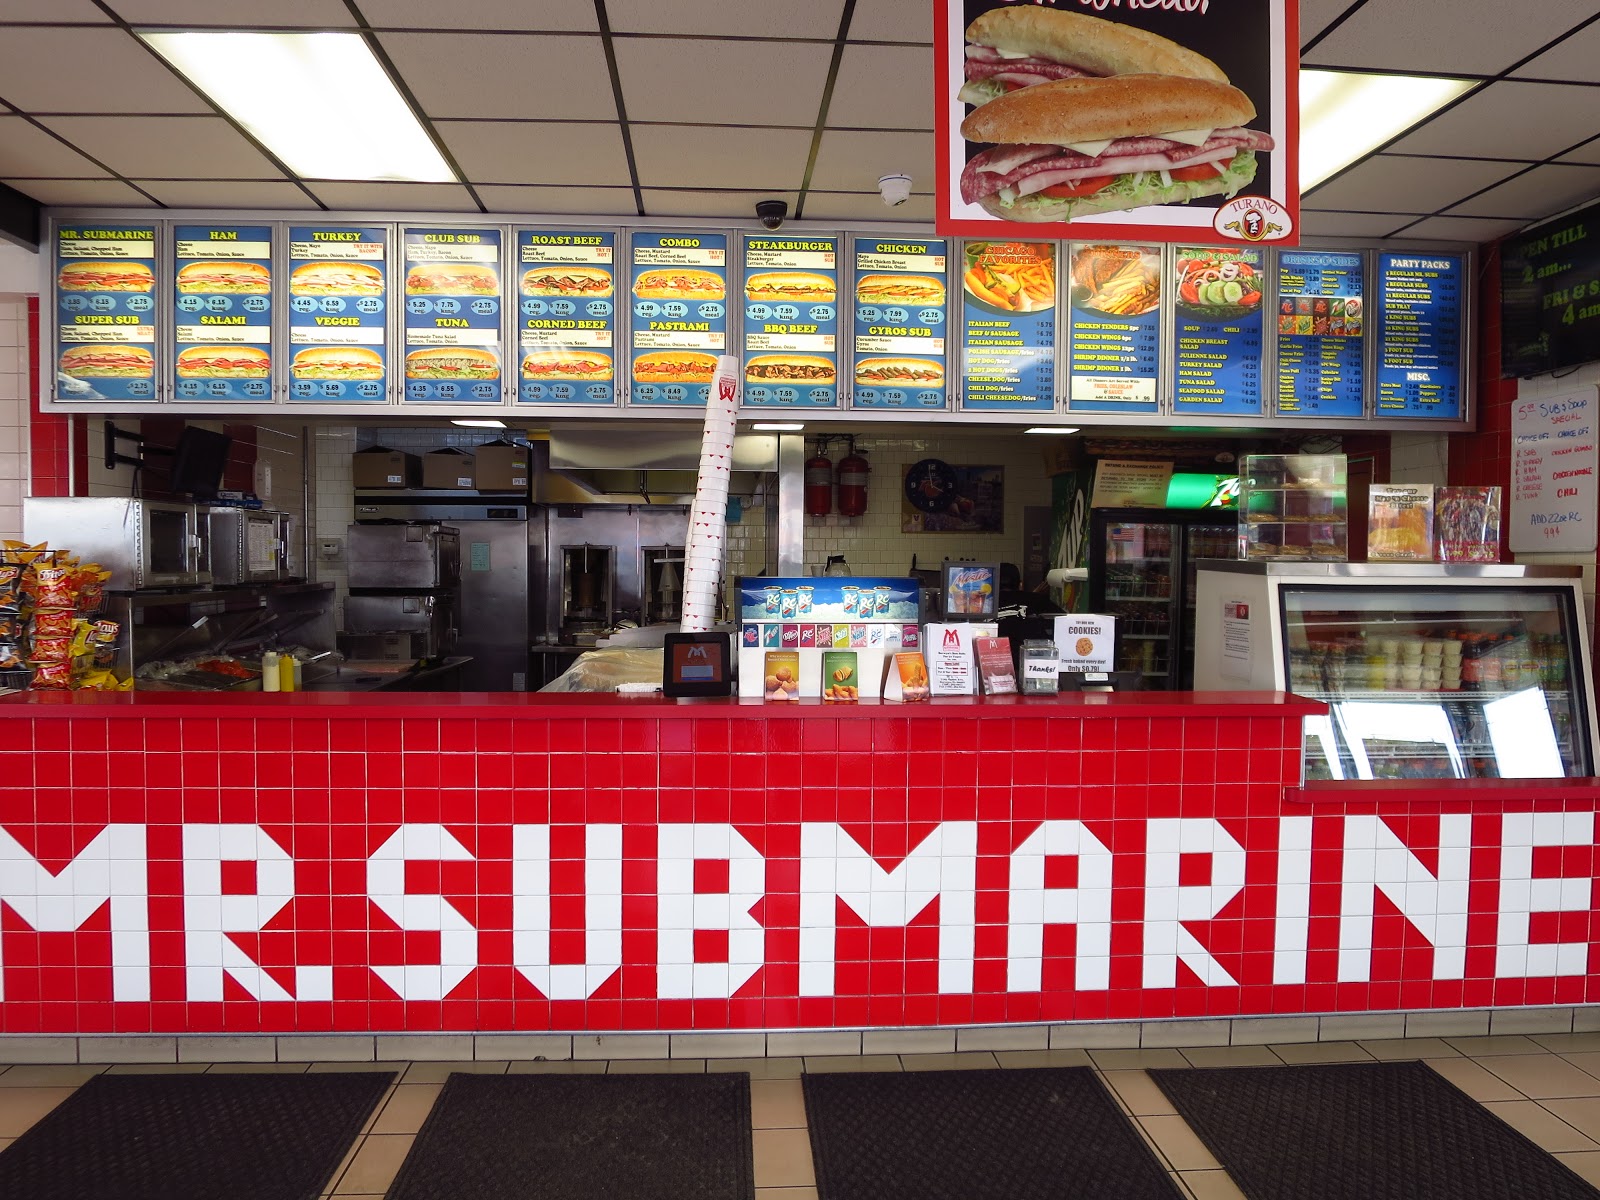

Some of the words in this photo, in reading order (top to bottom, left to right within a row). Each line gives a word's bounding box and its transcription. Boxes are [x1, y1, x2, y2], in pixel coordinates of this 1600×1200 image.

[1229, 200, 1278, 216] TURANO
[60, 231, 80, 239] MR.
[82, 231, 154, 239] SUBMARINE
[210, 231, 236, 240] HAM
[313, 232, 361, 241] TURKEY
[424, 234, 455, 243] CLUB
[457, 235, 480, 243] SUB
[532, 235, 571, 245] ROAST
[574, 236, 603, 245] BEEF
[1552, 224, 1587, 248] TILL
[660, 238, 700, 248] COMBO
[749, 241, 833, 251] STEAKBURGER
[876, 244, 926, 254] CHICKEN
[985, 246, 1036, 256] CHICAGO
[979, 255, 1041, 265] FAVORITES
[1182, 252, 1212, 261] SOUP
[1222, 254, 1259, 263] SALAD
[1391, 259, 1420, 268] PARTY
[1421, 260, 1450, 269] PACKS
[1543, 289, 1569, 310] FRI
[1572, 284, 1585, 300] &
[1562, 303, 1575, 325] 4
[75, 316, 114, 324] SUPER
[116, 316, 140, 324] SUB
[200, 316, 246, 325] SALAMI
[315, 317, 360, 326] VEGGIE
[435, 319, 469, 327] TUNA
[527, 320, 575, 329] CORNED
[578, 321, 607, 329] BEEF
[650, 322, 710, 331] PASTRAMI
[764, 325, 788, 334] BBQ
[790, 325, 818, 334] BEEF
[869, 326, 907, 336] GYROS
[909, 328, 932, 336] SUB
[1074, 322, 1100, 330] CHICKEN
[1407, 372, 1430, 381] MISC.
[766, 593, 781, 606] RC
[782, 597, 797, 610] RC
[798, 592, 813, 606] RC
[843, 592, 858, 606] RC
[860, 596, 875, 610] RC
[875, 592, 890, 606] RC
[802, 629, 814, 640] RC
[1029, 665, 1056, 673] Thanks!
